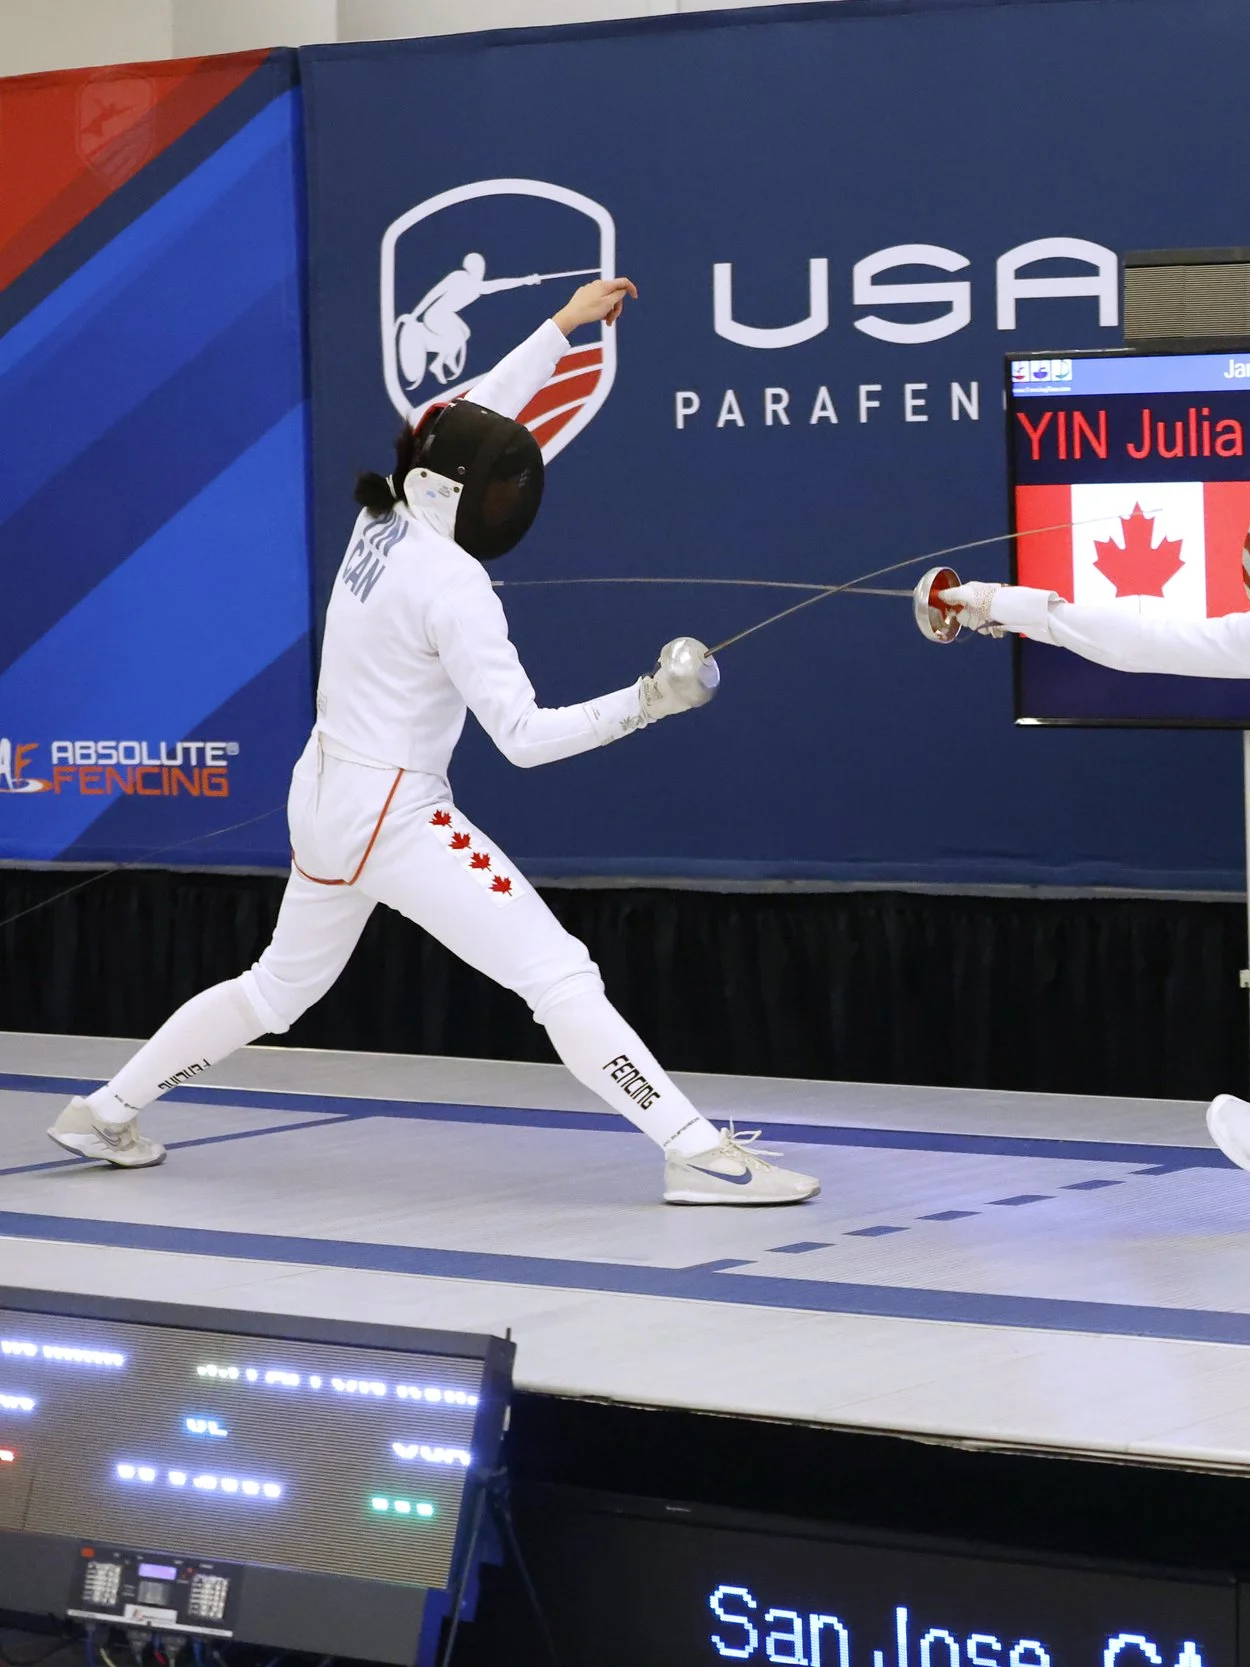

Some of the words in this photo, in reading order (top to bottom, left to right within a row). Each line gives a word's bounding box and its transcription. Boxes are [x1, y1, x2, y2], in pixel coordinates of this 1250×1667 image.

[713, 237, 1119, 349] USA
[676, 381, 1006, 429] PARAFEN
[1016, 410, 1108, 461] YIN
[1125, 407, 1244, 460] Julia
[342, 538, 386, 604] CAN
[53, 766, 229, 797] FENCING
[602, 1054, 661, 1110] FENCING
[709, 1585, 850, 1667] San
